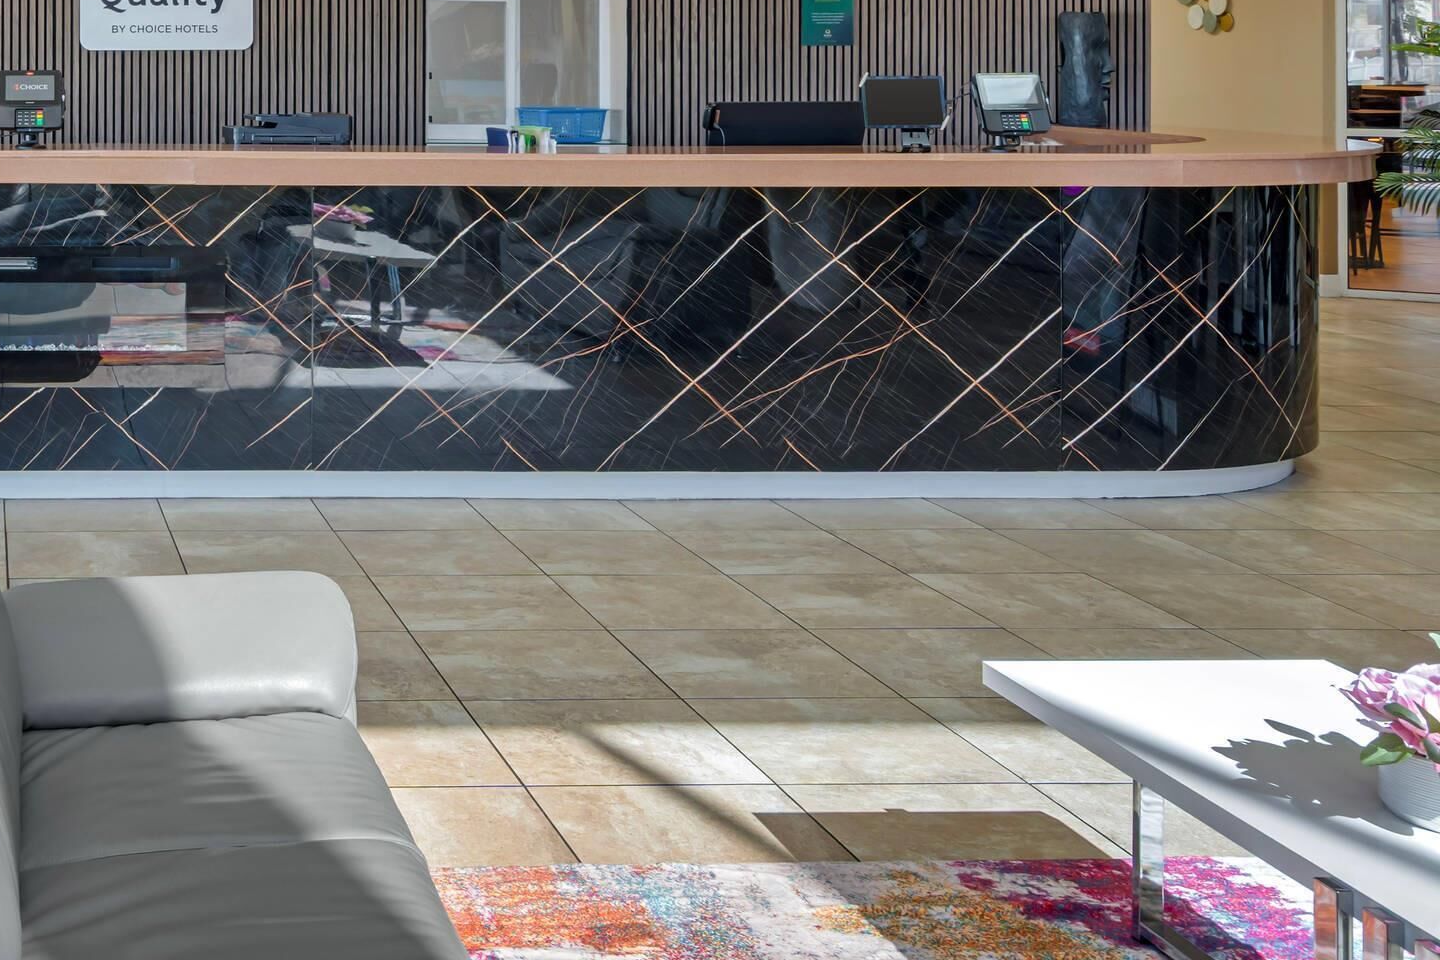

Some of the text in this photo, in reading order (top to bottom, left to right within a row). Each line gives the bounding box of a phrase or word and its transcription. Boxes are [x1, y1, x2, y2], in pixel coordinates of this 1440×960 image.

[112, 24, 218, 34] BY CHOICE HOTELS
[19, 83, 49, 91] CHOICE
